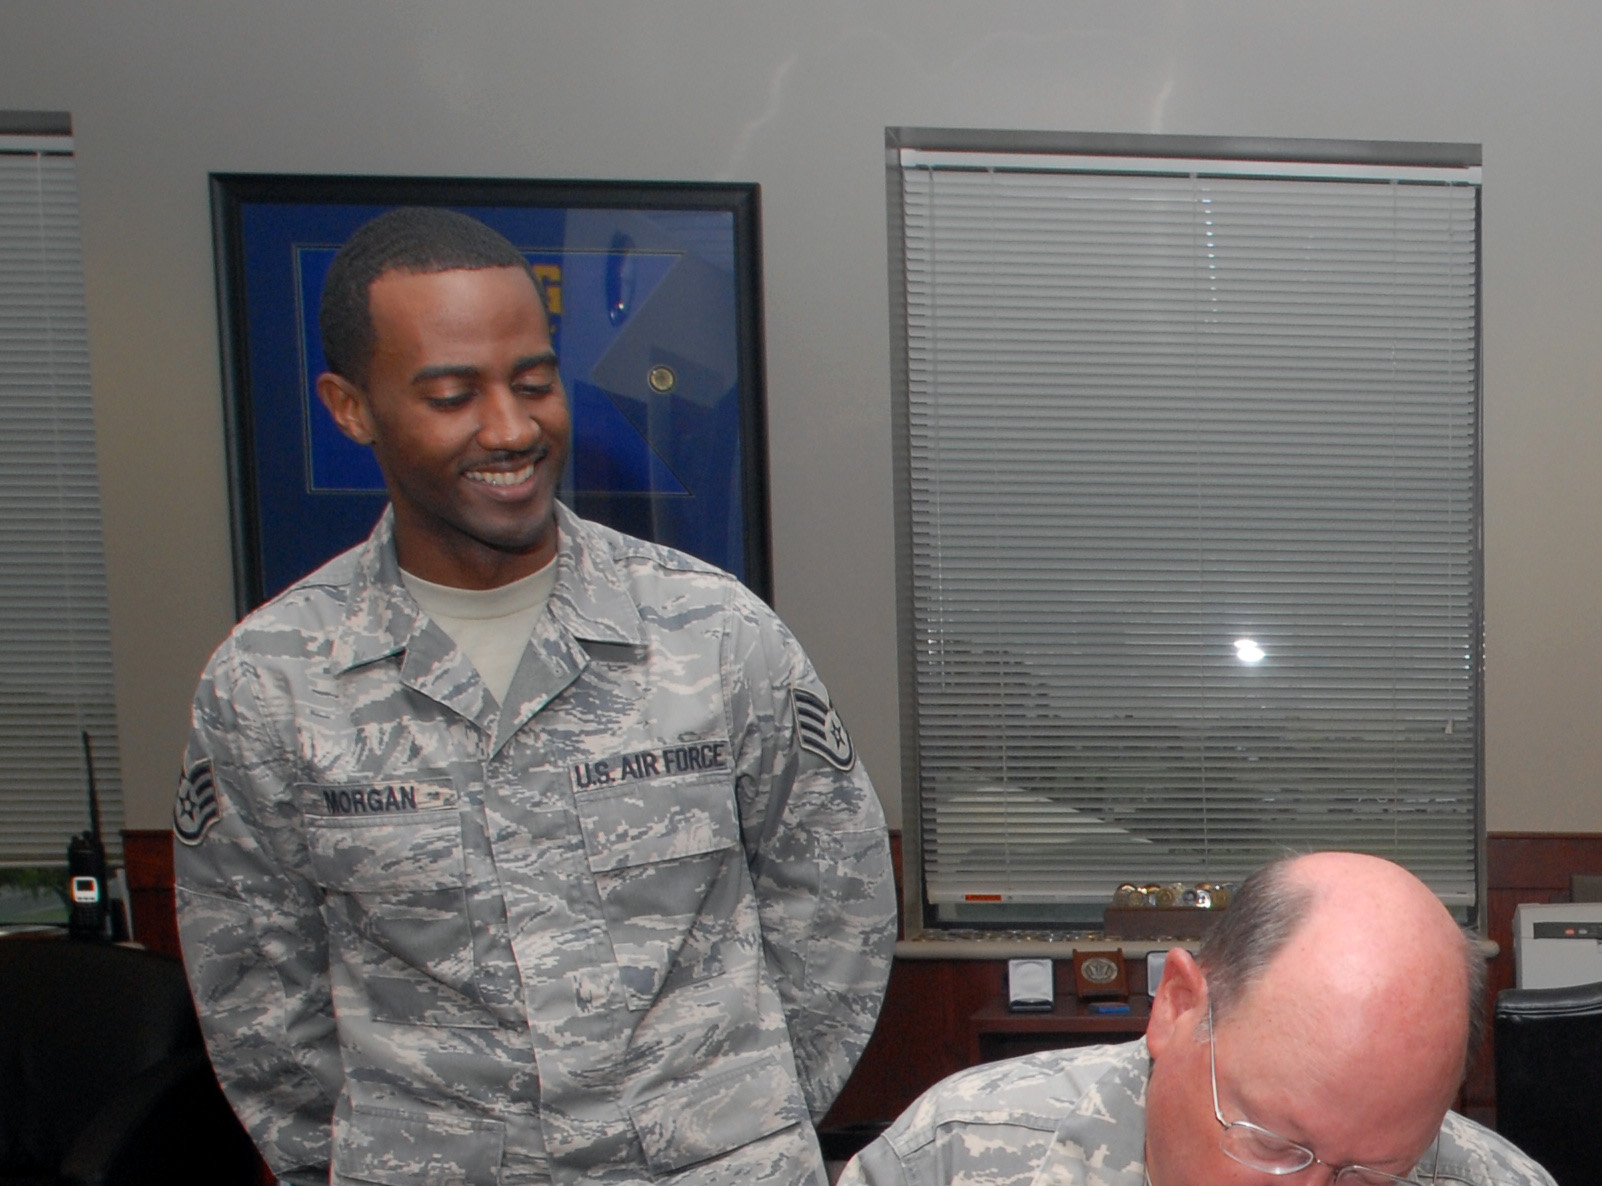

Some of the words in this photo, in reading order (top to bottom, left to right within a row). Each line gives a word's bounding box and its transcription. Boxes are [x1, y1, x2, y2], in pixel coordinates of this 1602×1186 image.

[575, 761, 616, 788] U.S.
[621, 750, 660, 781] AIR
[663, 743, 726, 773] FORCE
[323, 785, 417, 814] MORGAN
